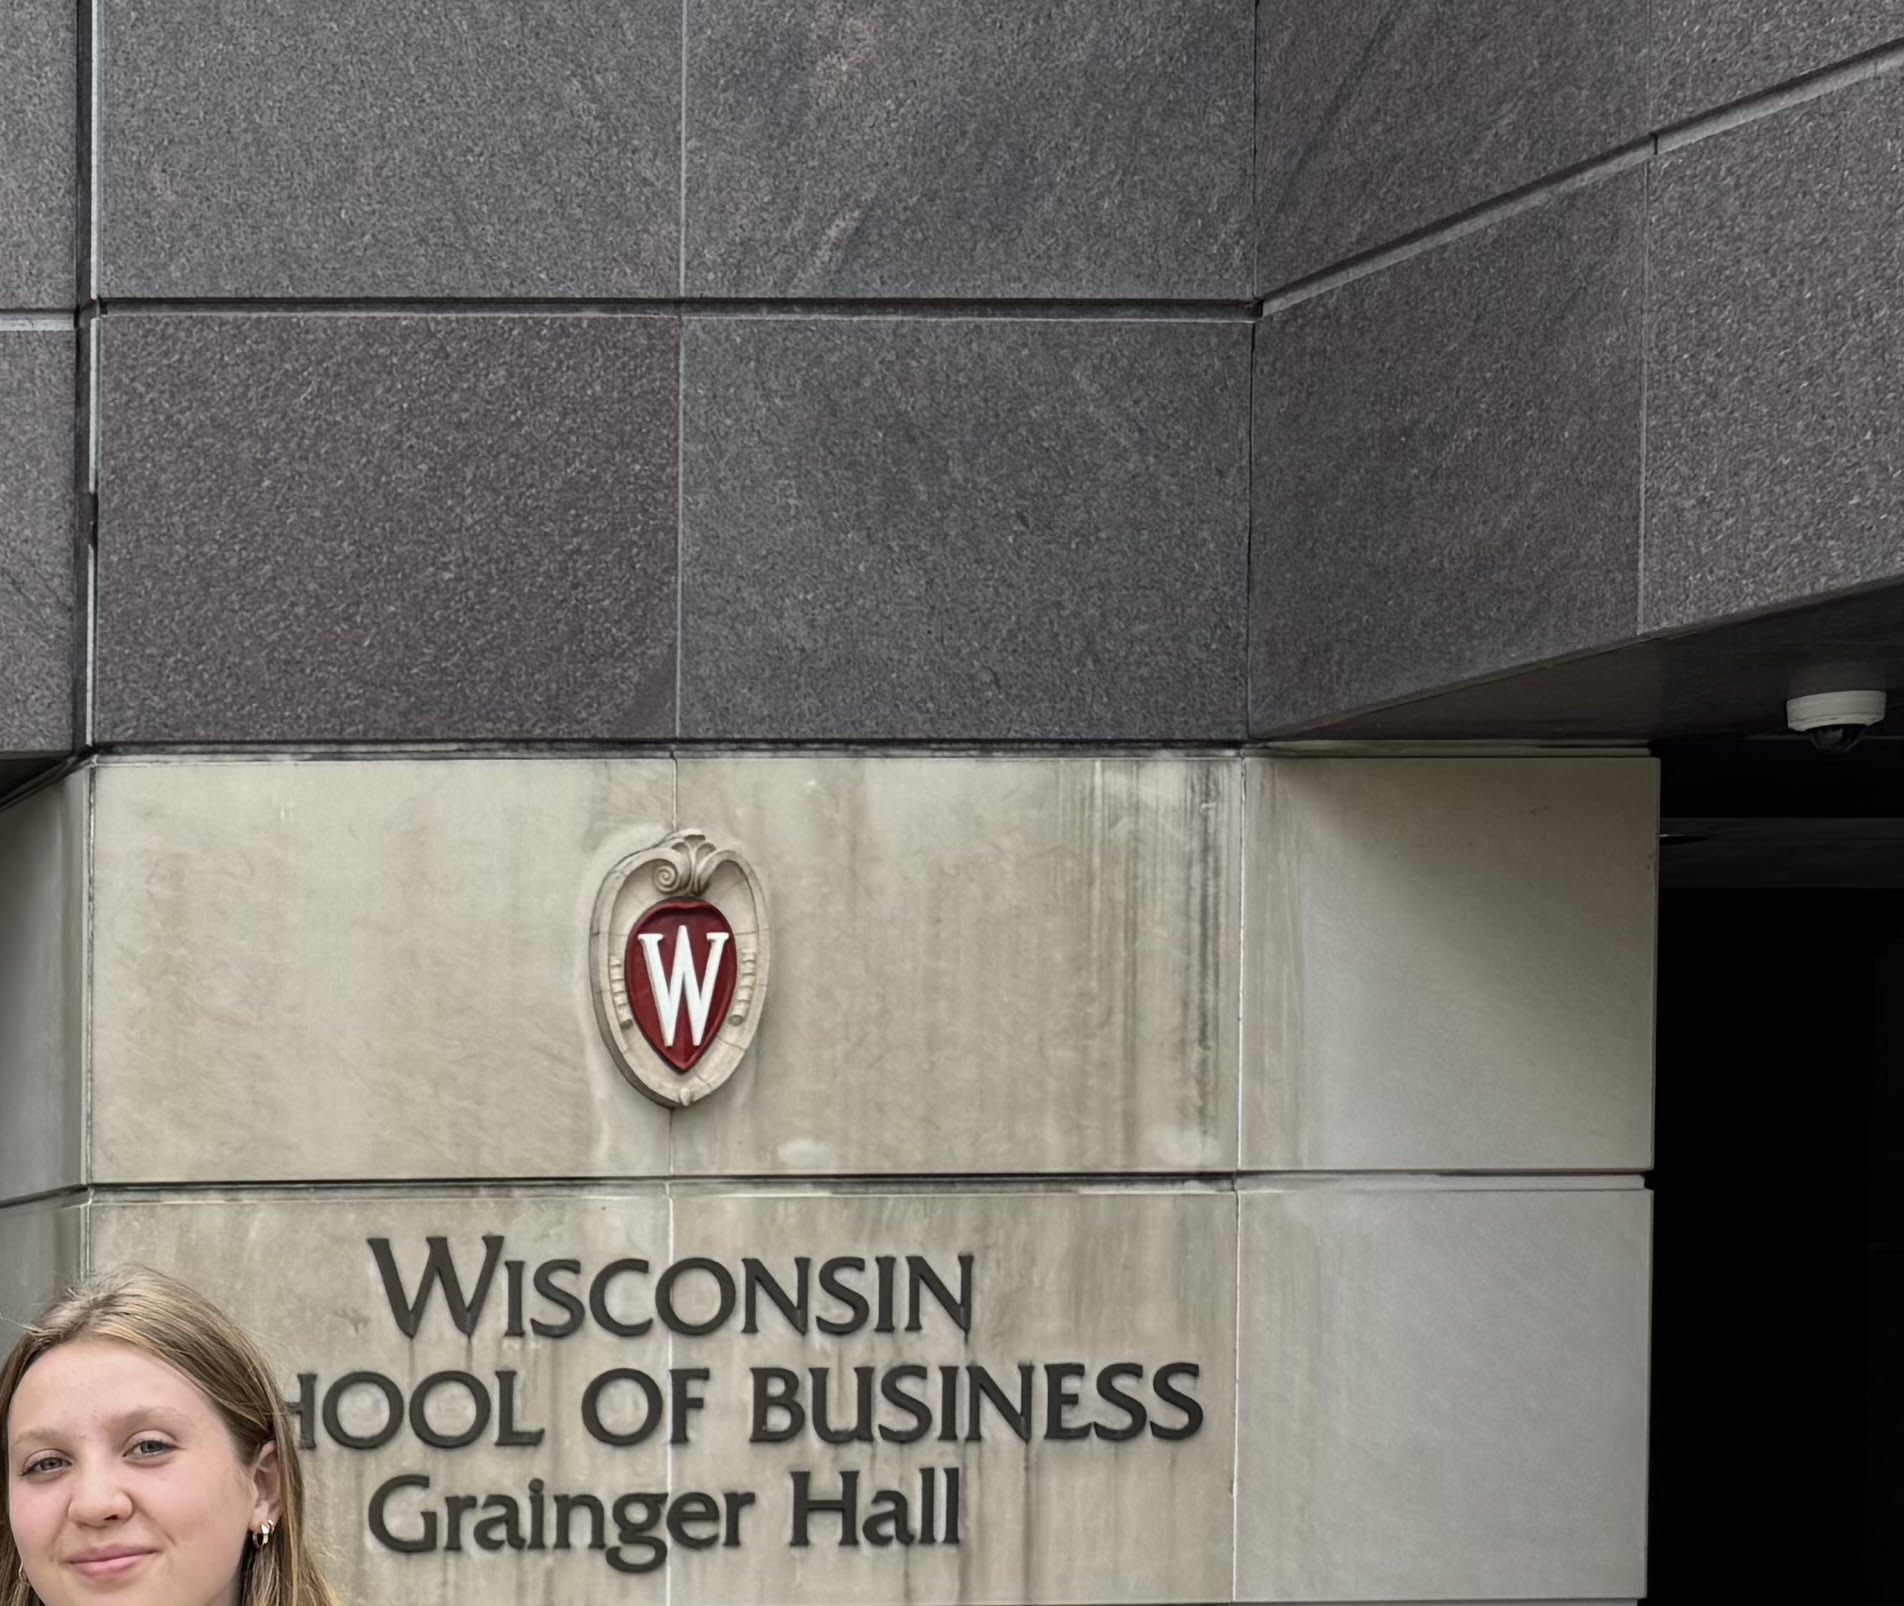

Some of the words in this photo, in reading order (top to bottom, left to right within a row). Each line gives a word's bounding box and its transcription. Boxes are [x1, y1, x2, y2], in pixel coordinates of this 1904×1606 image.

[637, 925, 730, 1047] W
[367, 1234, 975, 1338] WISCONSIN
[286, 1368, 545, 1450] HOOL
[580, 1366, 711, 1448] OF
[748, 1361, 1205, 1446] BUSINESS
[366, 1474, 755, 1575] Grainger
[790, 1467, 961, 1549] Hall
